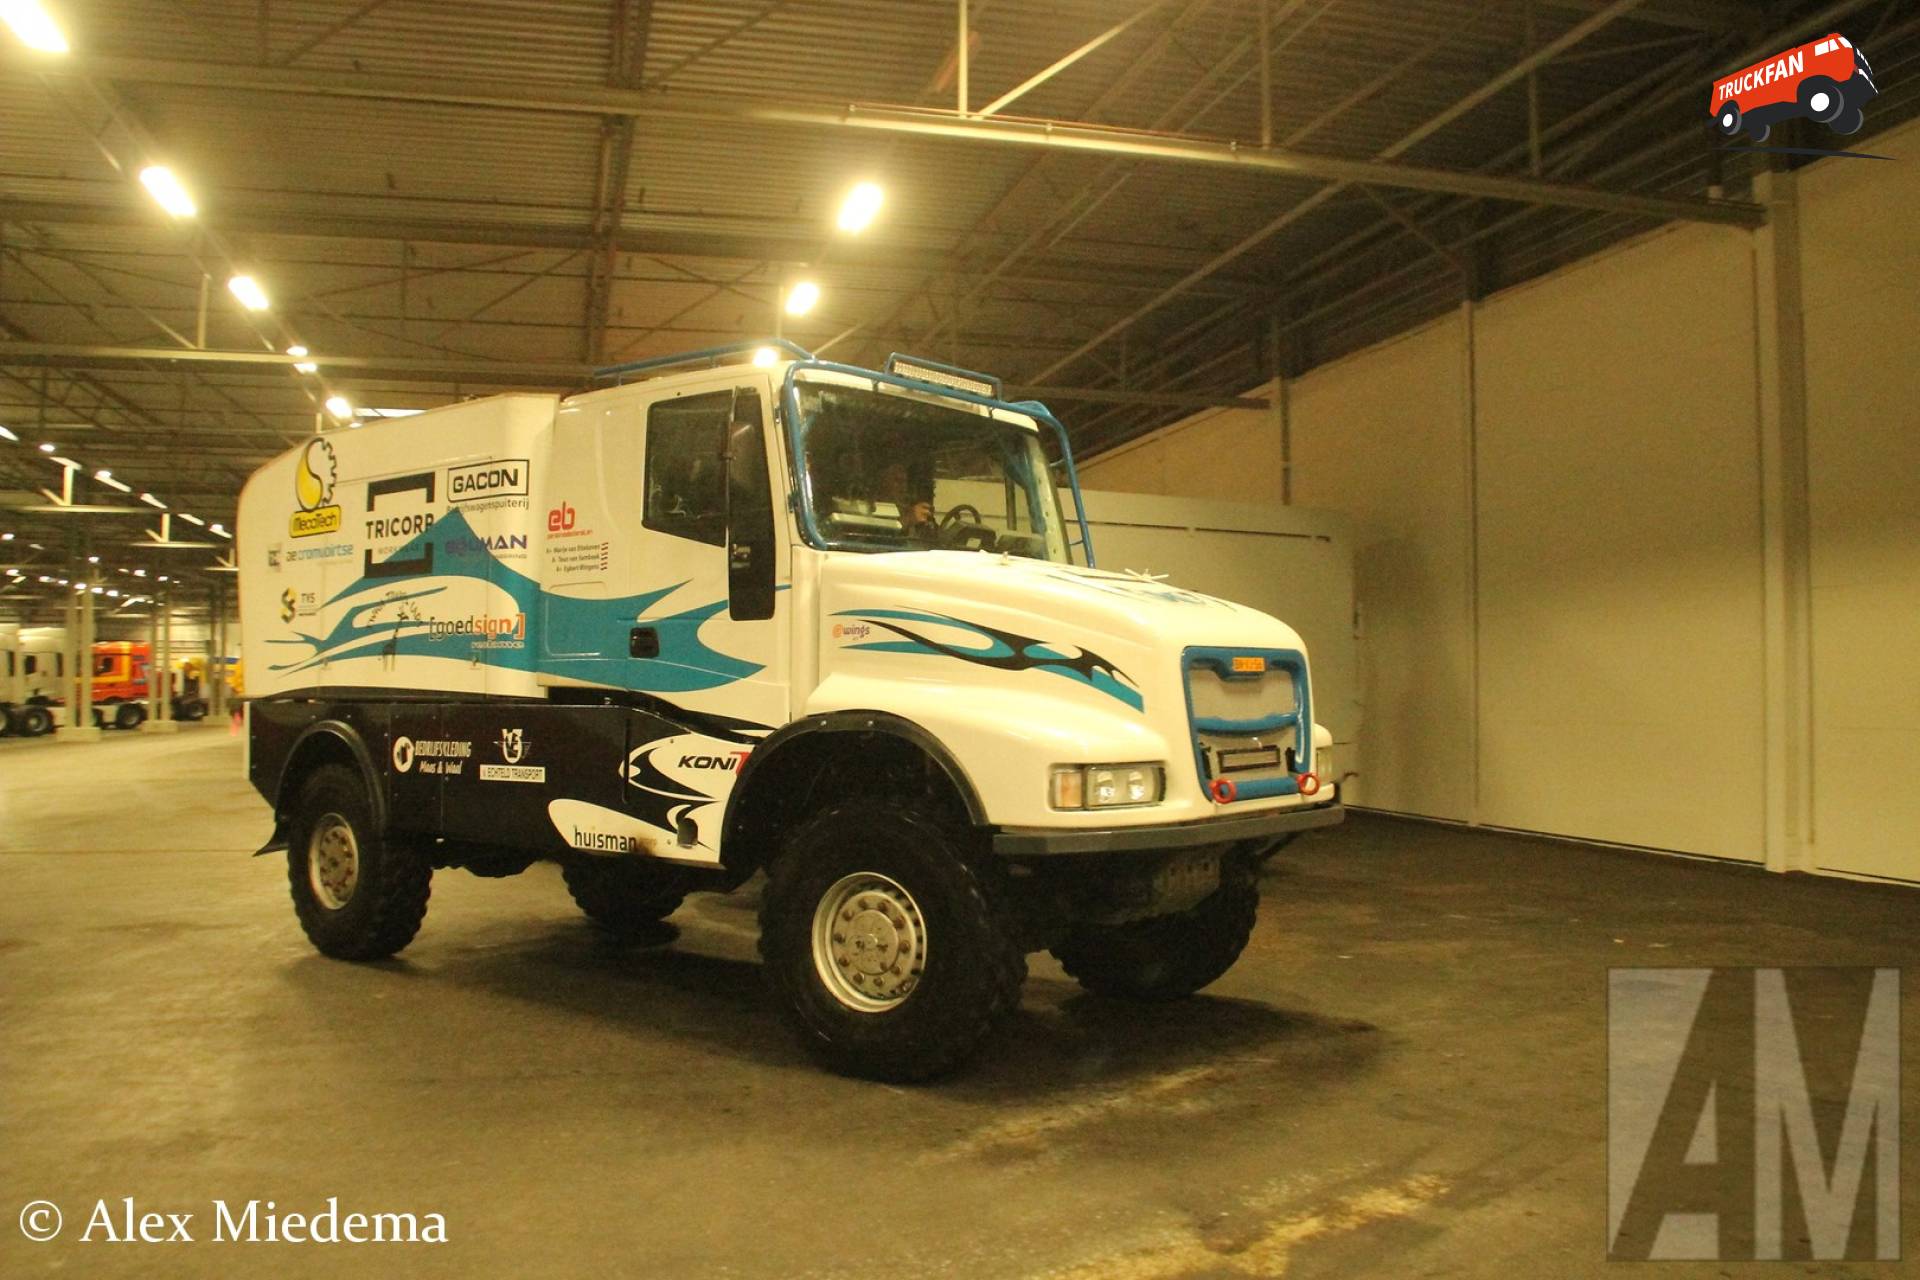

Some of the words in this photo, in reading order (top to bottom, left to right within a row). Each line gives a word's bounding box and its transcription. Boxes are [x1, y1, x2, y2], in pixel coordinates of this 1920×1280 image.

[453, 468, 518, 494] GACON
[365, 512, 435, 539] TRICORP
[678, 755, 738, 771] KONI
[573, 825, 637, 851] huisman
